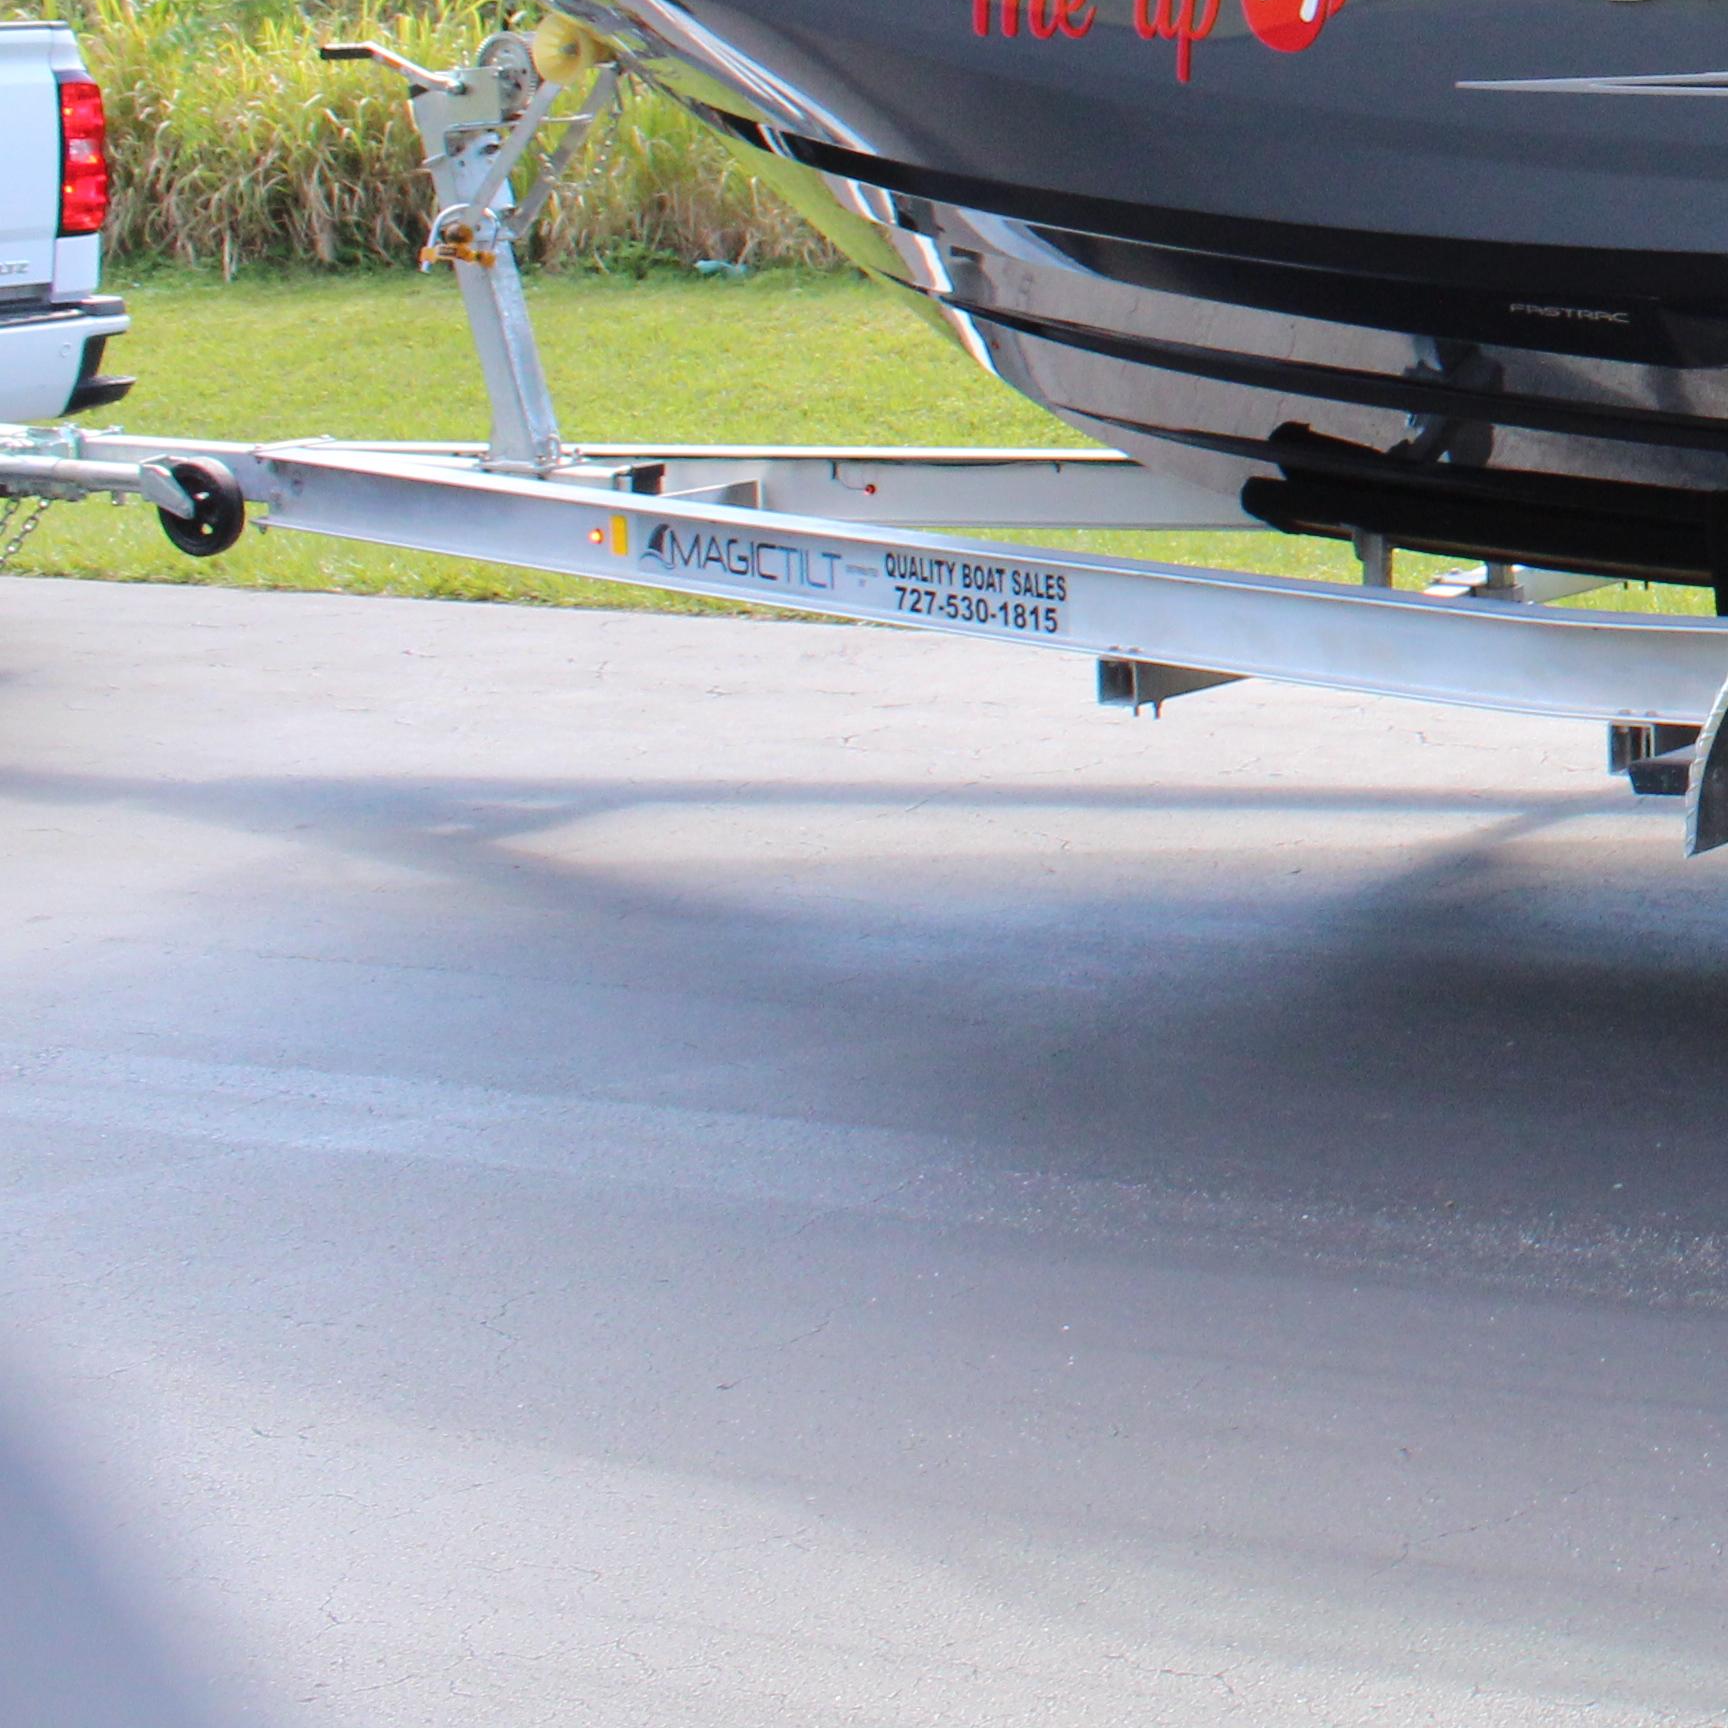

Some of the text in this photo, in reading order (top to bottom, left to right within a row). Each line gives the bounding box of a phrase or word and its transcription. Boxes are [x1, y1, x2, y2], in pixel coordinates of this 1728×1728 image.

[1509, 303, 1630, 324] FASTRAC
[885, 552, 957, 585] QUALITY
[962, 564, 1006, 593] BOAT
[1012, 569, 1067, 602] SALES
[895, 586, 1058, 633] 727-530-1815
